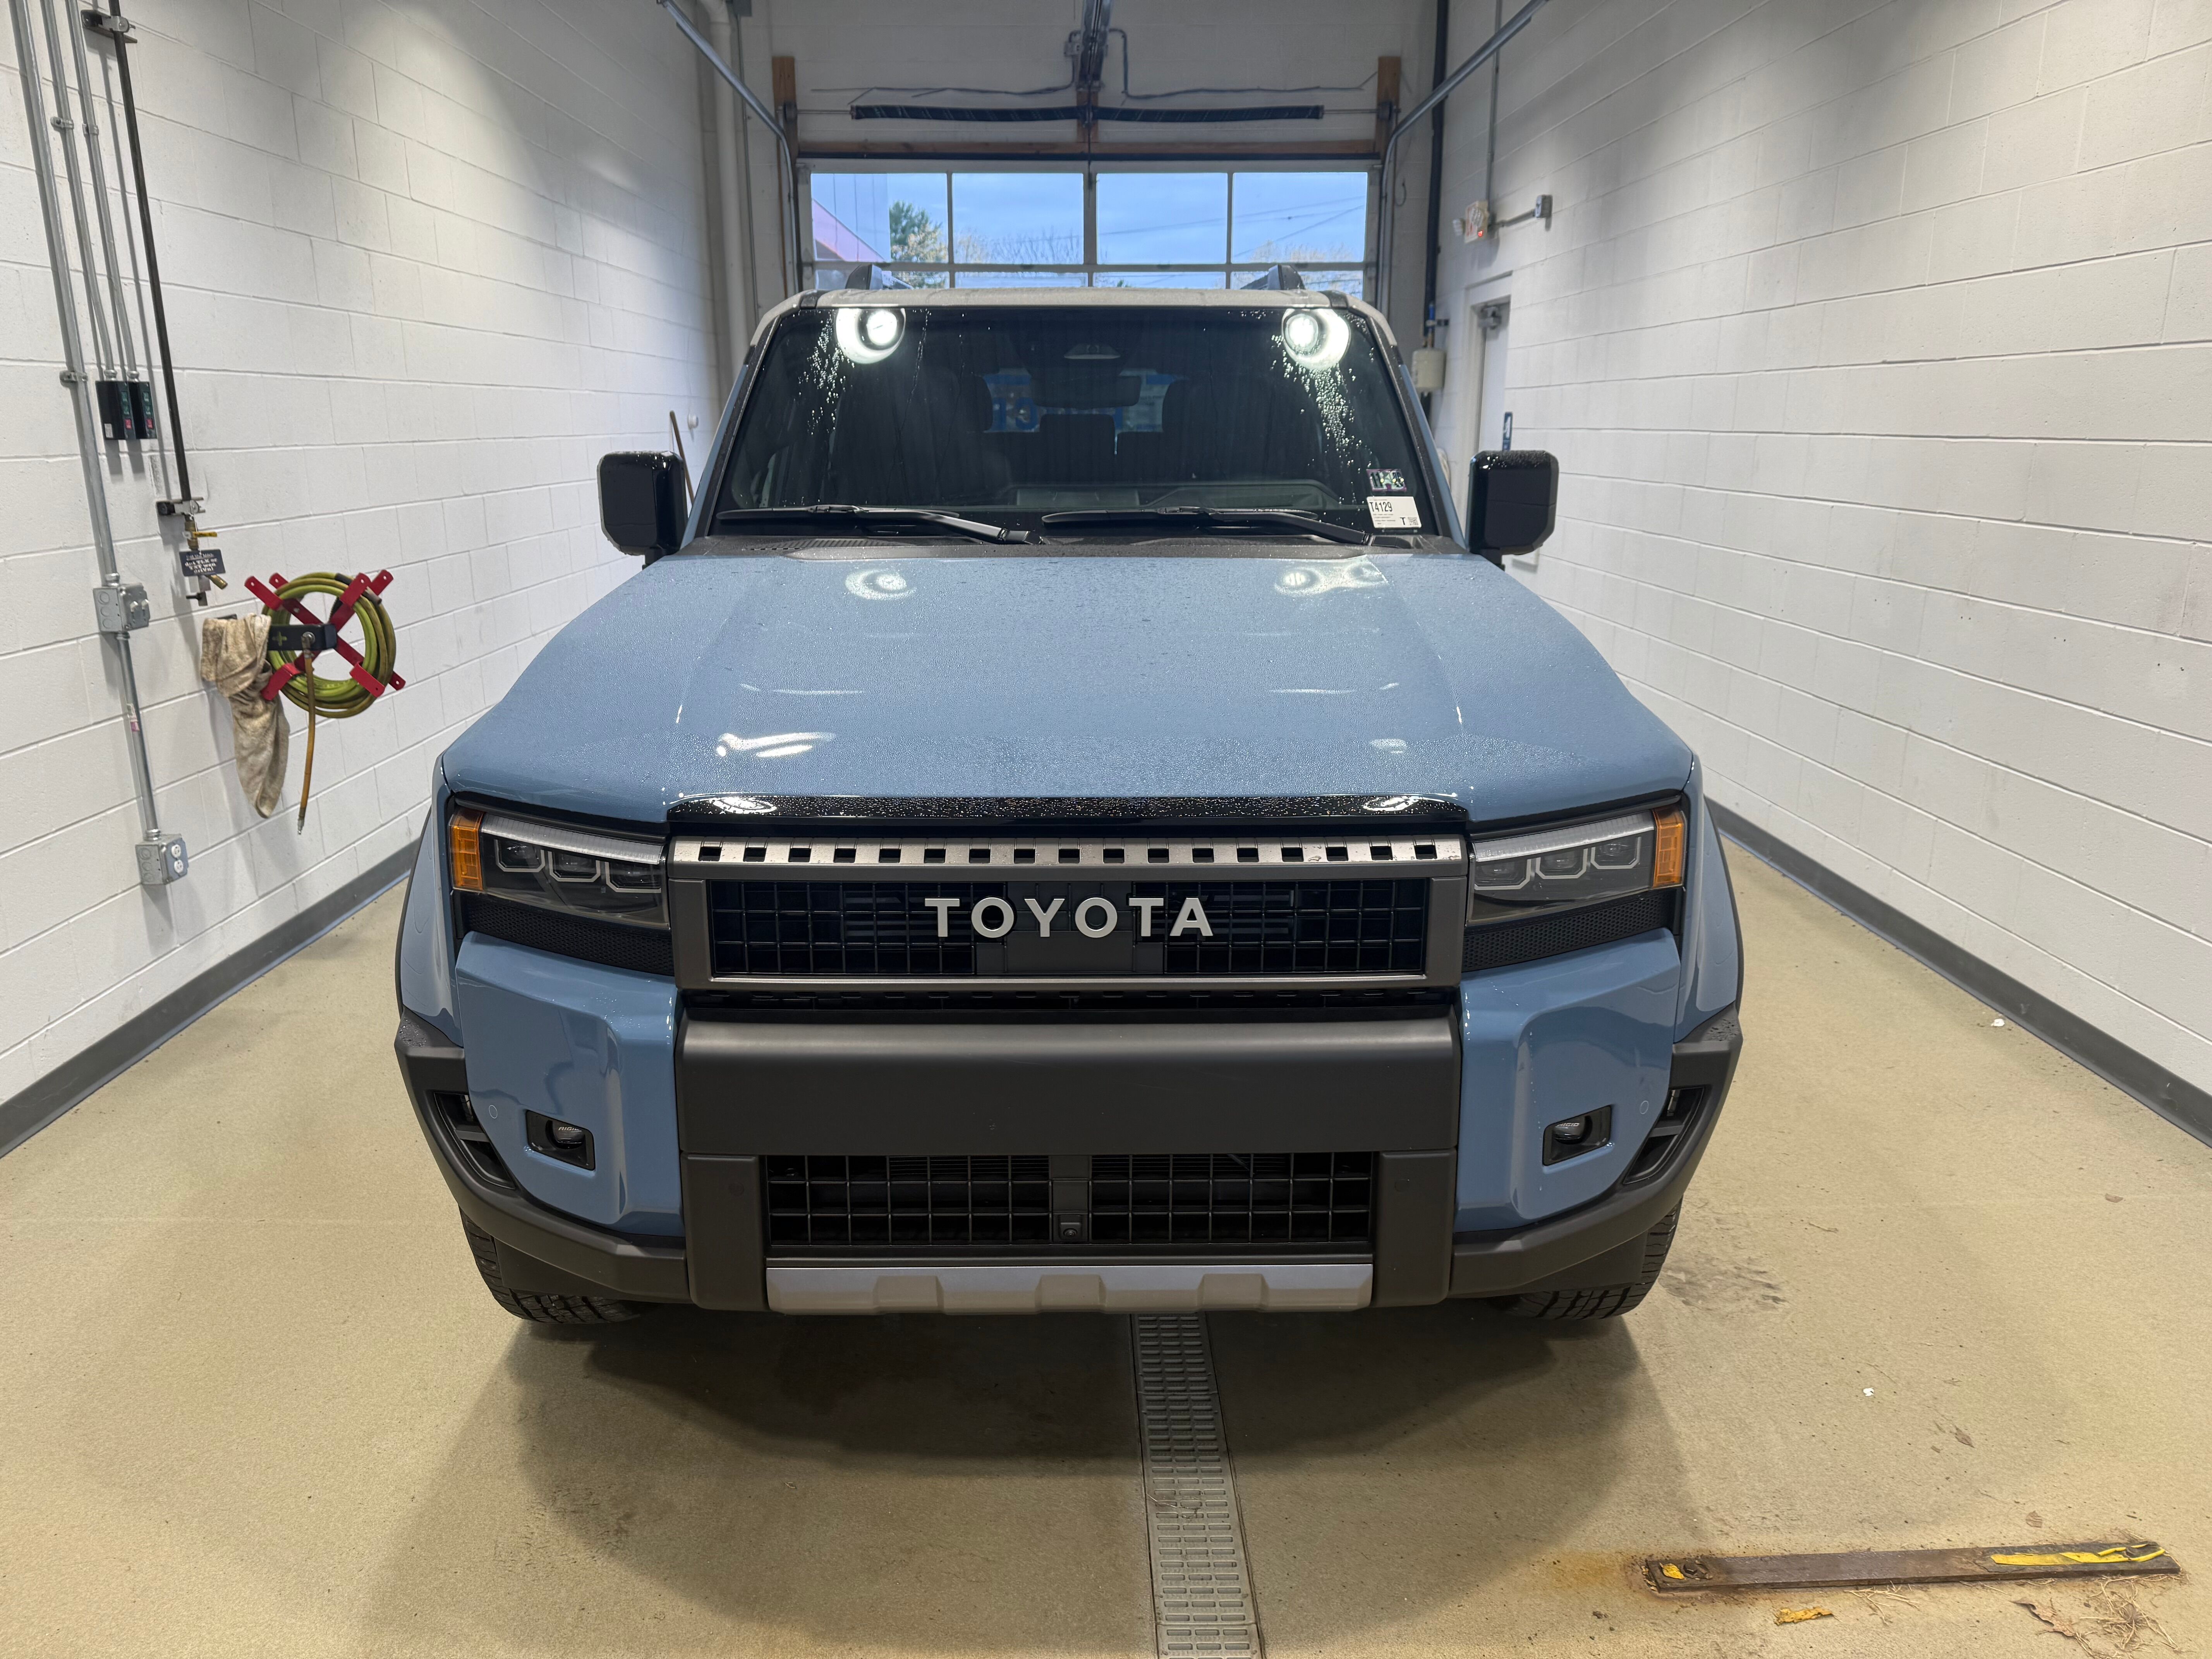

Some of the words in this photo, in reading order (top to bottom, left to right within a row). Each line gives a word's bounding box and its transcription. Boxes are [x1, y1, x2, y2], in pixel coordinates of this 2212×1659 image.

[1369, 502, 1393, 512] T4129
[1400, 517, 1406, 525] T
[925, 897, 1213, 938] TOYOTA
